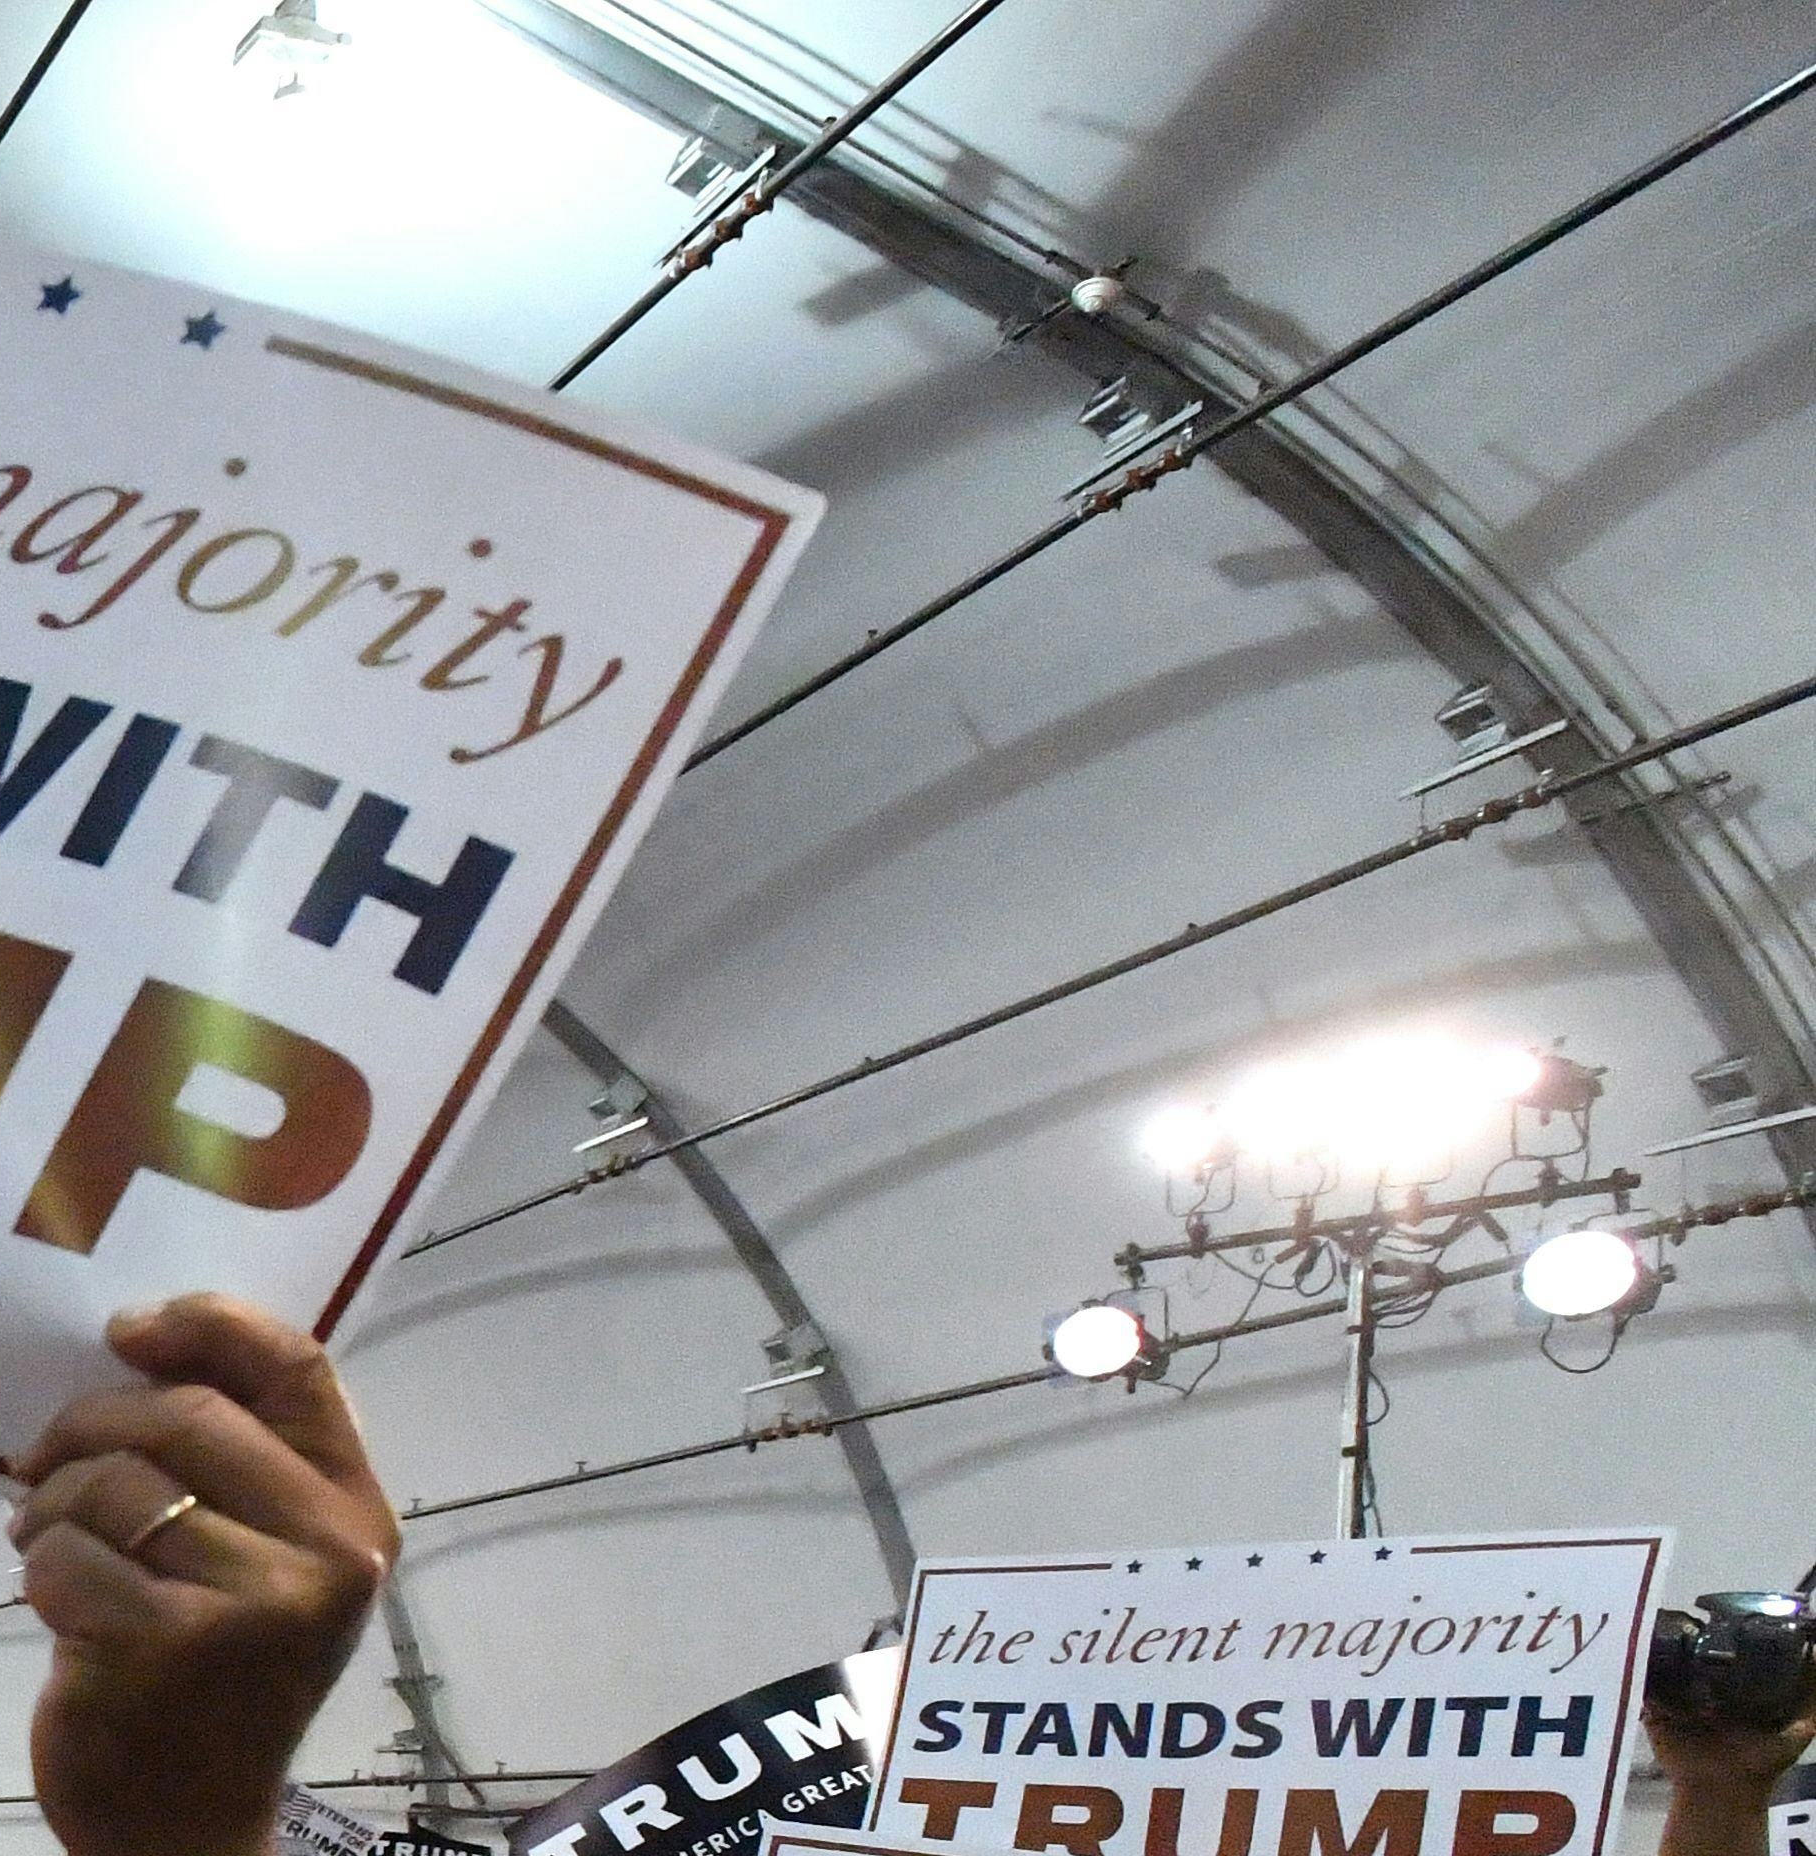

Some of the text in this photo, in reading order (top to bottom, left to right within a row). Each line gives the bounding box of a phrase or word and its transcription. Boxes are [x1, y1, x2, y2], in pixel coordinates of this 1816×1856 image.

[926, 1590, 1609, 1678] the silent majority
[912, 1694, 1594, 1759] STANDS WITH
[781, 1763, 872, 1814] GREAT
